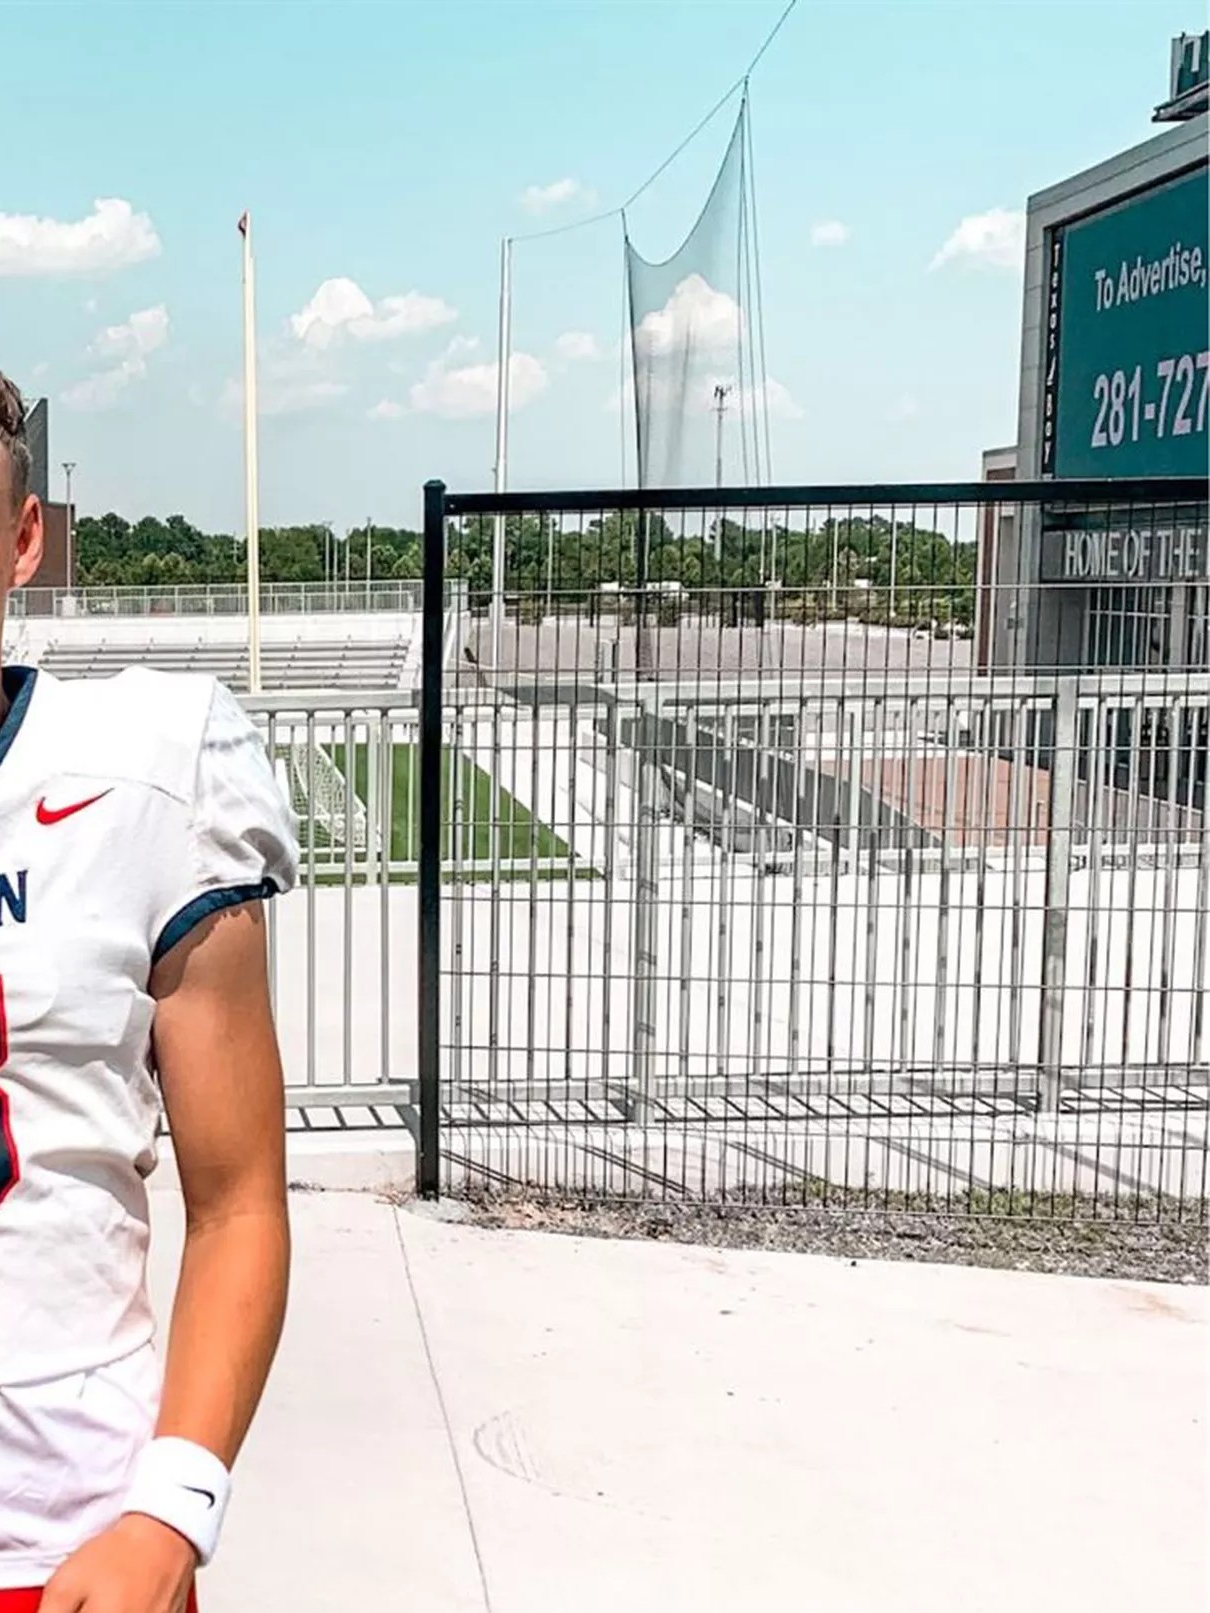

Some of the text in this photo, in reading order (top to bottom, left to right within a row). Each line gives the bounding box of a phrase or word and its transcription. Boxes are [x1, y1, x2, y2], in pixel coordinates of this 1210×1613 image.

[1094, 241, 1206, 312] To Advertise,
[1091, 351, 1209, 447] 281-727
[1064, 530, 1121, 577] HOME
[1123, 529, 1152, 577] OF
[1157, 528, 1202, 577] THE
